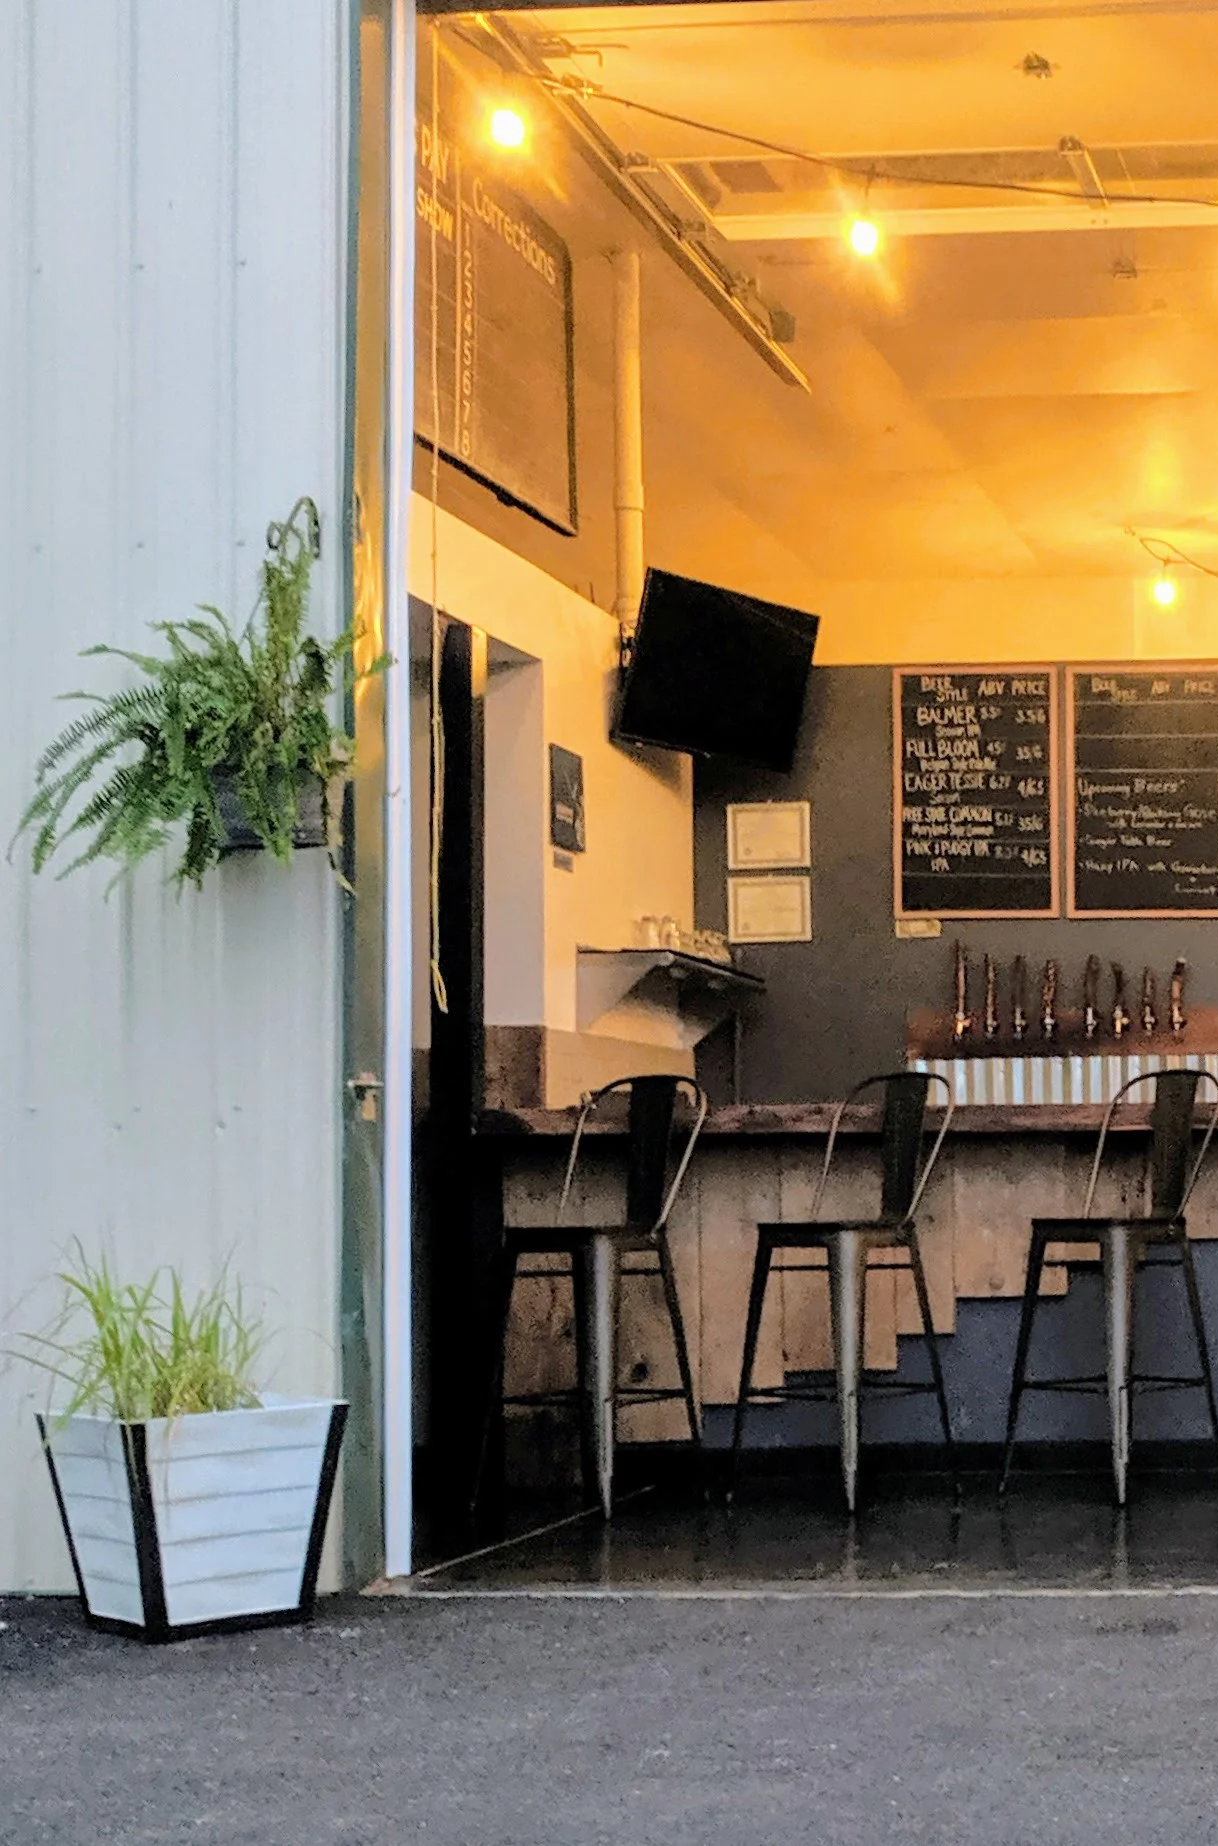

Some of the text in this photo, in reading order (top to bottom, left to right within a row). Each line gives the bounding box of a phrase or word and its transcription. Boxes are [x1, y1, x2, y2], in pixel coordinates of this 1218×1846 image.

[421, 124, 450, 185] PAY
[416, 186, 454, 242] SHOW
[473, 177, 556, 285] Corrections
[936, 687, 968, 702] STYLE
[977, 680, 1006, 696] ABV
[1011, 679, 1047, 696] PRICE
[906, 738, 936, 758] FULL
[937, 739, 980, 759] BLOOM
[904, 773, 949, 792] EAGER
[1116, 859, 1139, 872] IPA
